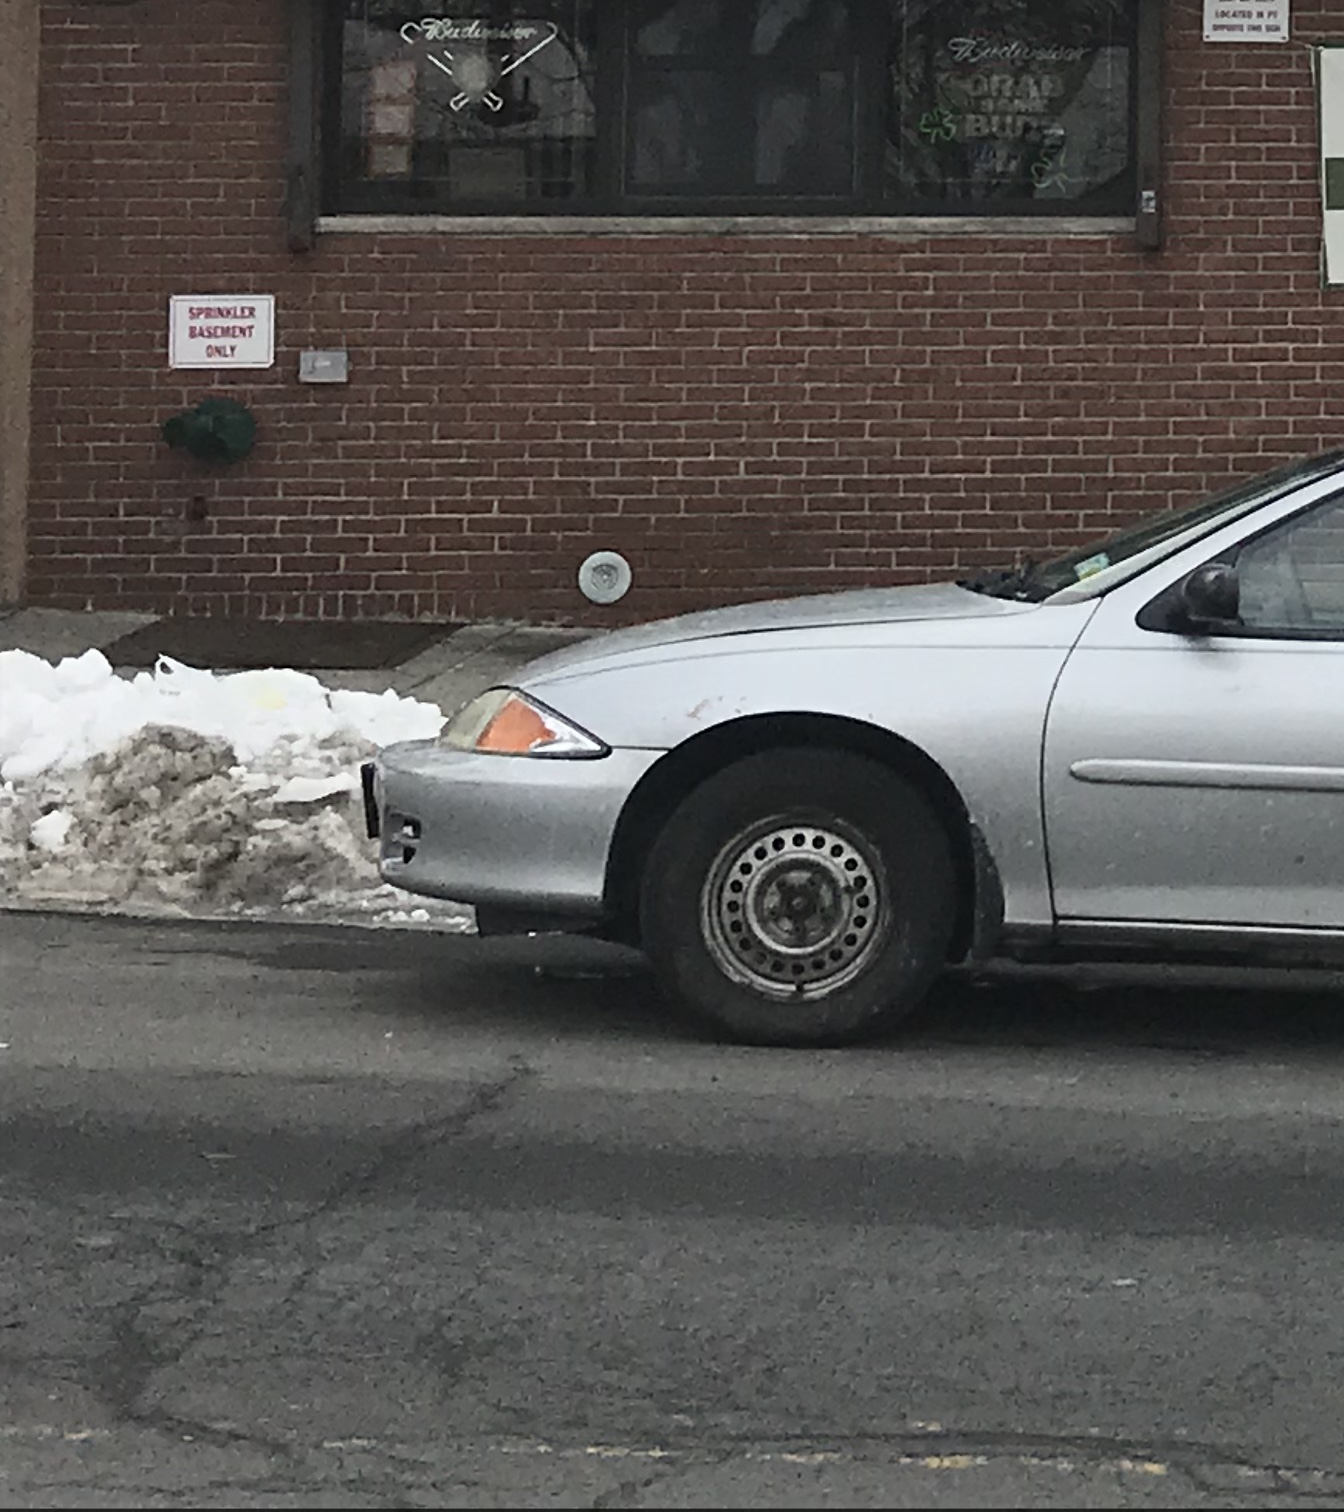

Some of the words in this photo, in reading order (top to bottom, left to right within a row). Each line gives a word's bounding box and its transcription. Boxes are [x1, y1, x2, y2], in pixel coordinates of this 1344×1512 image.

[421, 18, 537, 40] Budweiser
[948, 38, 1092, 62] Budweiser
[188, 305, 256, 320] SPRINKLER
[188, 325, 255, 339] BASEMENT
[205, 344, 238, 358] ONLY
